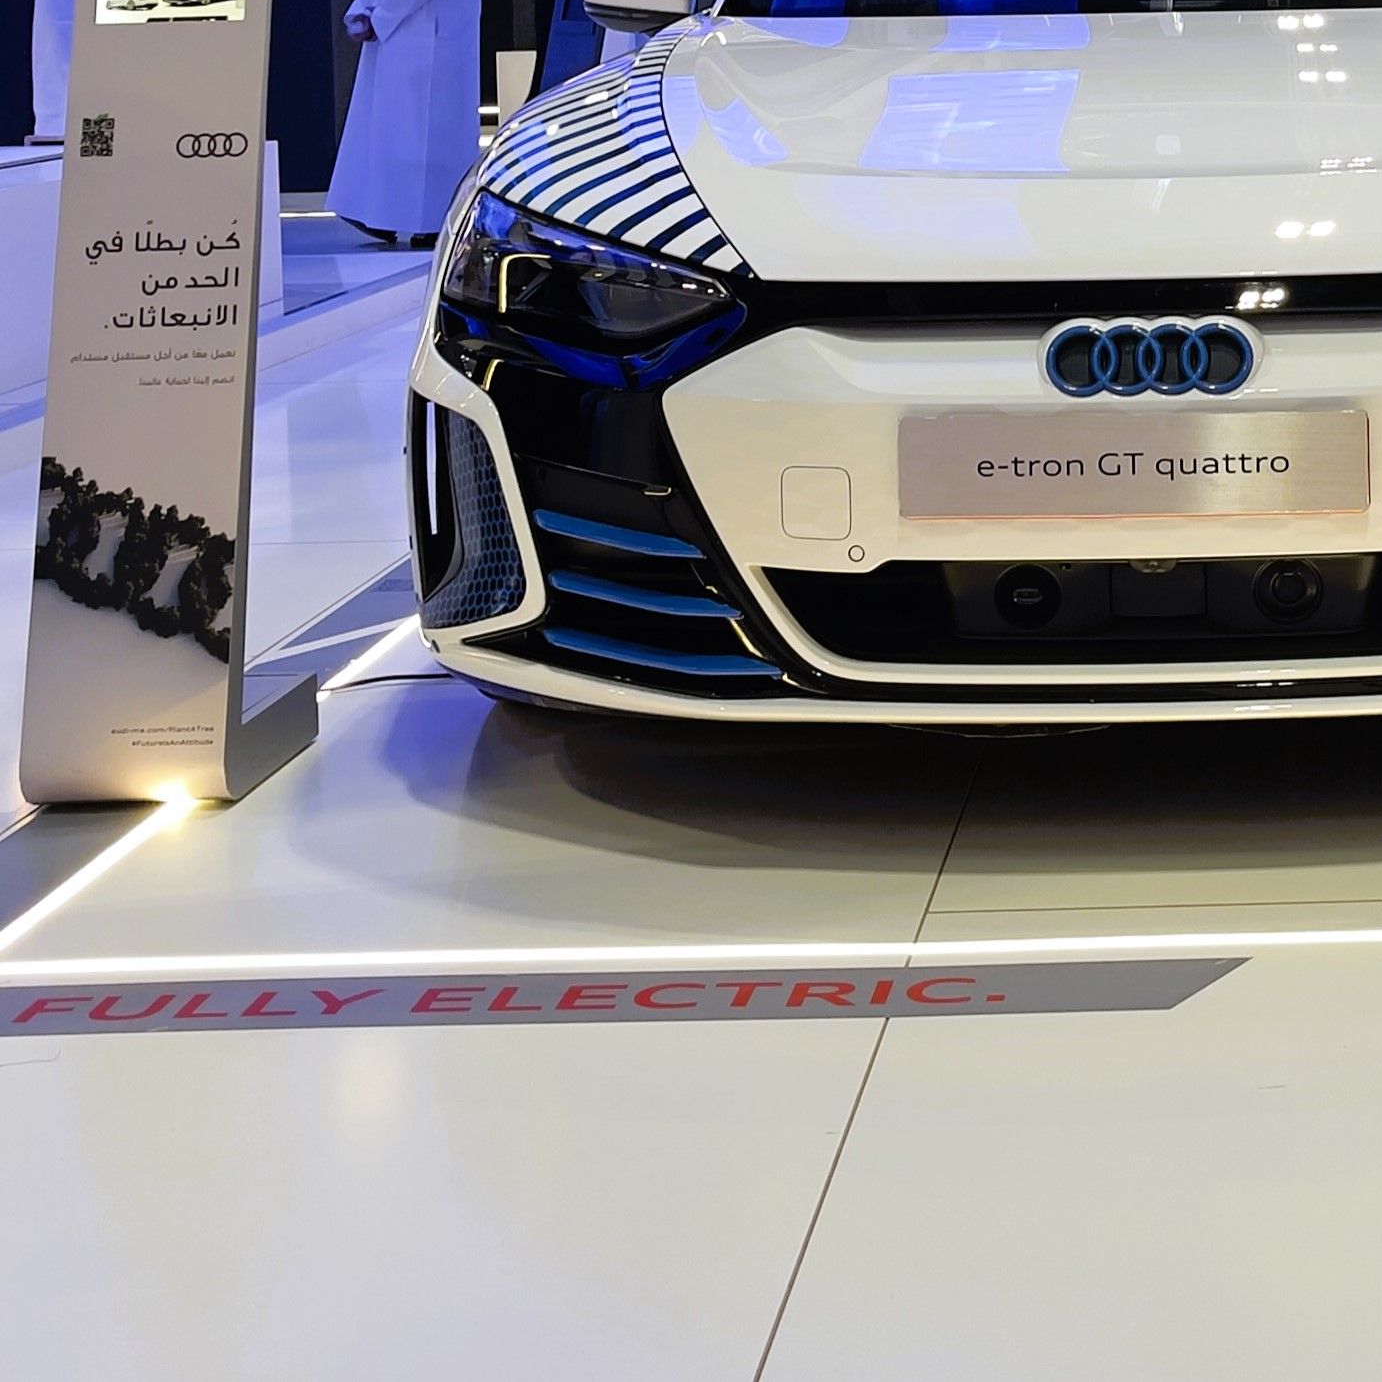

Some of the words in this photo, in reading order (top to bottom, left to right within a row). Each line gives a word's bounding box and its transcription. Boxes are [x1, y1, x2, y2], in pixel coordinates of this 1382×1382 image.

[85, 230, 123, 265] في
[141, 274, 178, 296] من
[184, 266, 239, 289] الحد
[104, 304, 238, 331] الانبعاثات.
[977, 456, 1084, 477] e-tron
[1097, 452, 1144, 476] GT
[1155, 453, 1290, 481] quattro
[12, 989, 386, 1023] FULLY
[411, 978, 1005, 1013] ELECTRIC.
